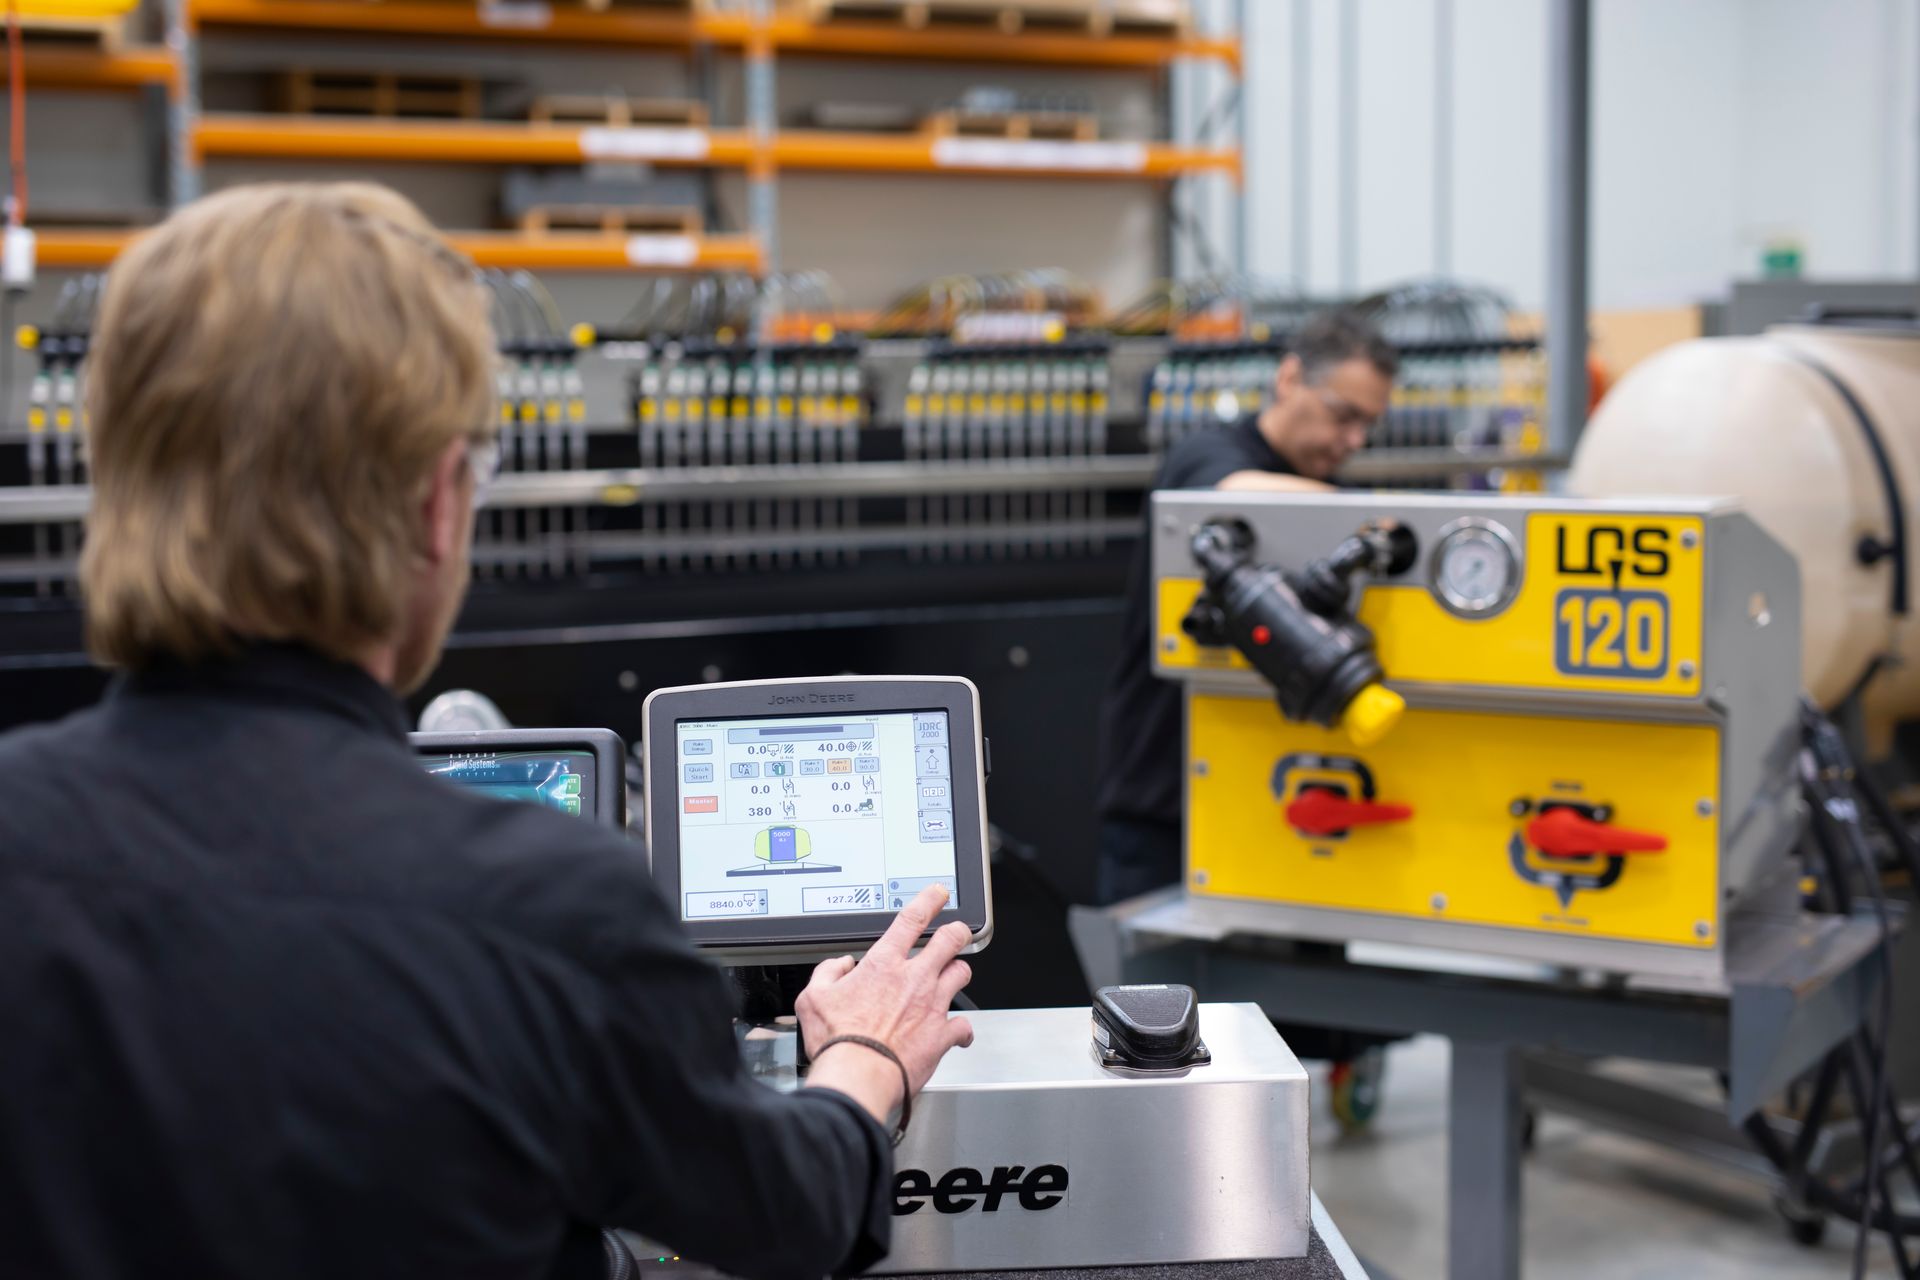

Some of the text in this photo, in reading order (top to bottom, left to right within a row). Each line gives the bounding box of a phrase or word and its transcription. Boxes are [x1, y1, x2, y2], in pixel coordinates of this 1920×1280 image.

[1559, 596, 1665, 671] 120
[767, 693, 856, 705] JOHN DEERE
[917, 721, 942, 731] JDRC
[747, 745, 767, 755] 0.0
[817, 742, 845, 752] 40.0
[449, 759, 468, 771] Liquid
[468, 759, 496, 771] Systems
[750, 785, 770, 794] 0.0
[831, 781, 851, 791] 0.0
[748, 806, 772, 817] 380
[832, 803, 852, 813] 0.0
[709, 899, 744, 909] 8840.0
[826, 895, 854, 904] 127.2
[892, 1163, 1069, 1216] eere
